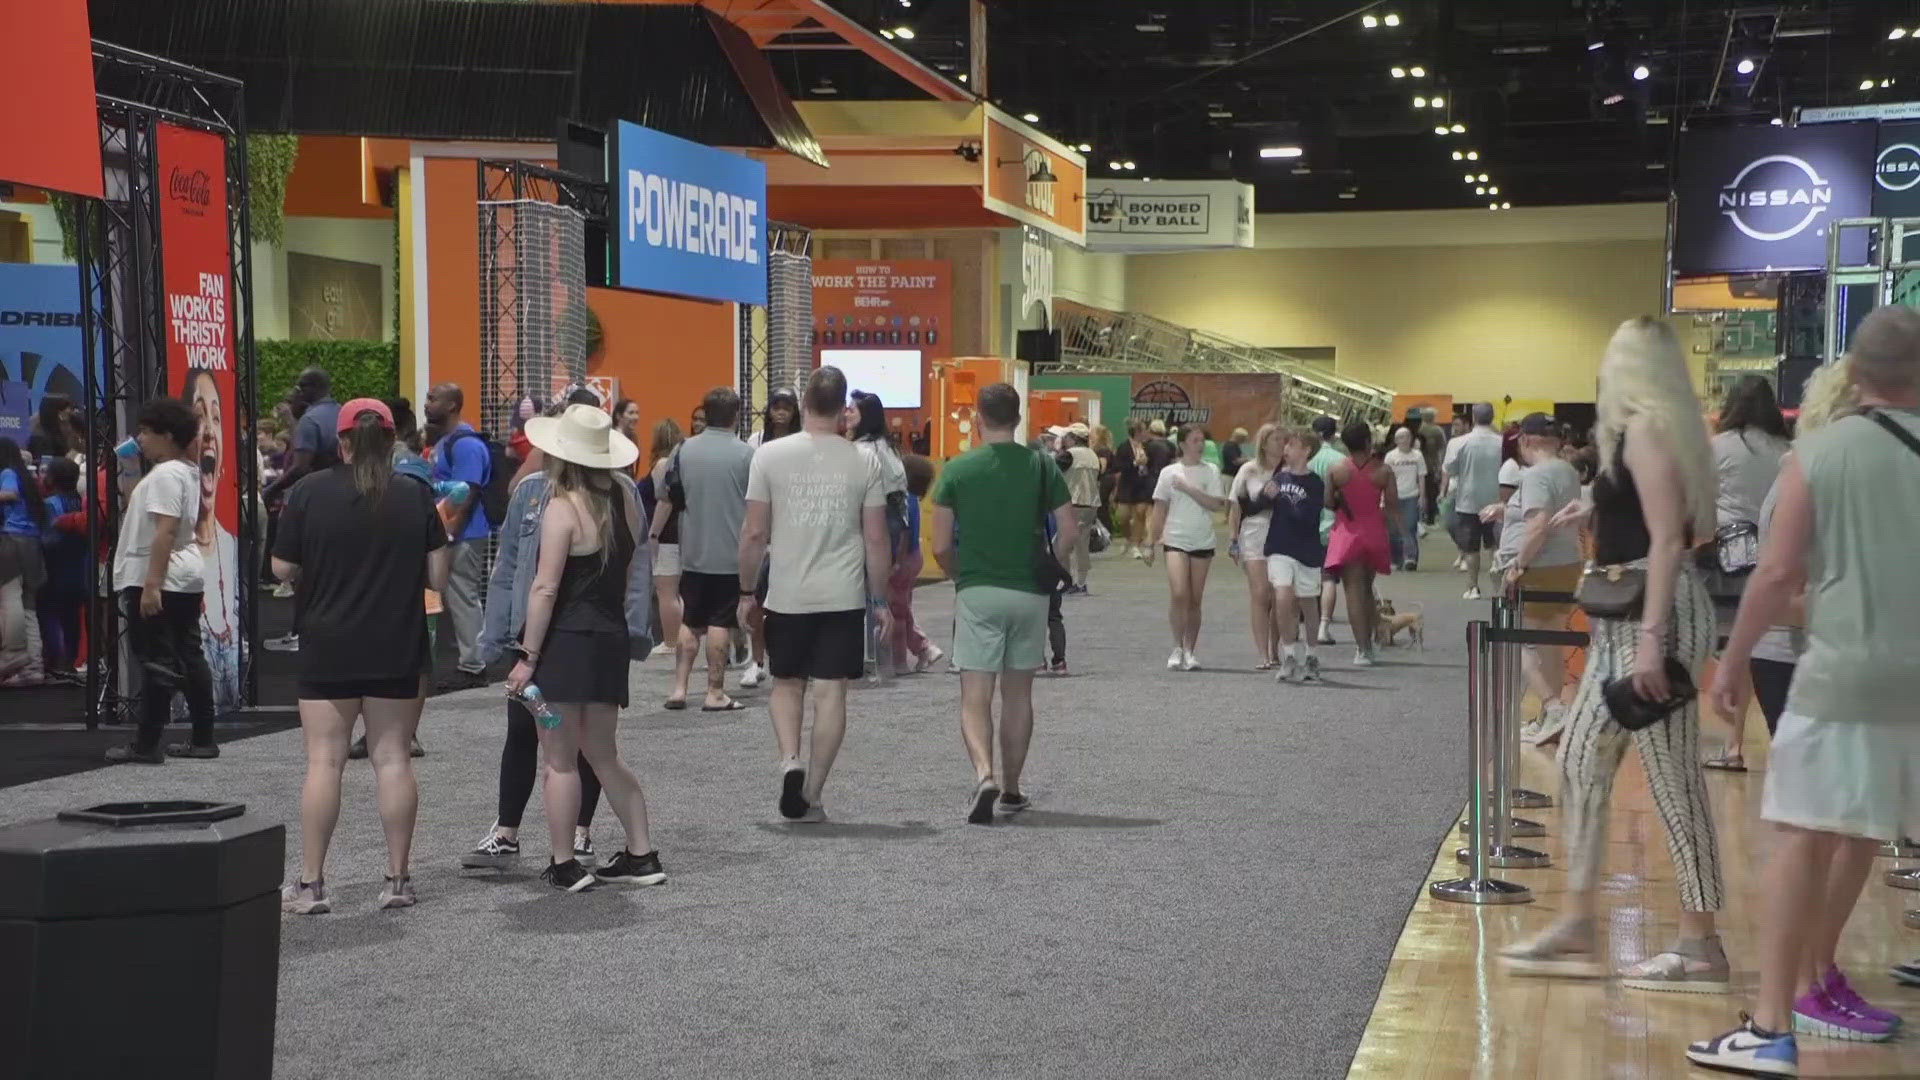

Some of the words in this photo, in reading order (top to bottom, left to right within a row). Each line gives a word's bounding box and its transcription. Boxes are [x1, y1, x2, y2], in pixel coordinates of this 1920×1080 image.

[1719, 187, 1832, 208] NISSAN
[628, 169, 758, 265] POWERADE
[1129, 203, 1201, 214] BONDED
[1129, 216, 1150, 226] BY
[1156, 216, 1200, 226] BALL
[856, 266, 877, 275] HOW
[879, 266, 891, 275] TO
[199, 271, 224, 299] FAN
[811, 276, 854, 288] WORK
[858, 276, 887, 289] THE
[890, 276, 936, 289] PAINT
[169, 293, 212, 322] WORK
[212, 298, 225, 323] IS
[171, 319, 226, 347] THRISTY
[185, 344, 228, 371] WORK
[1173, 409, 1208, 423] TOWN
